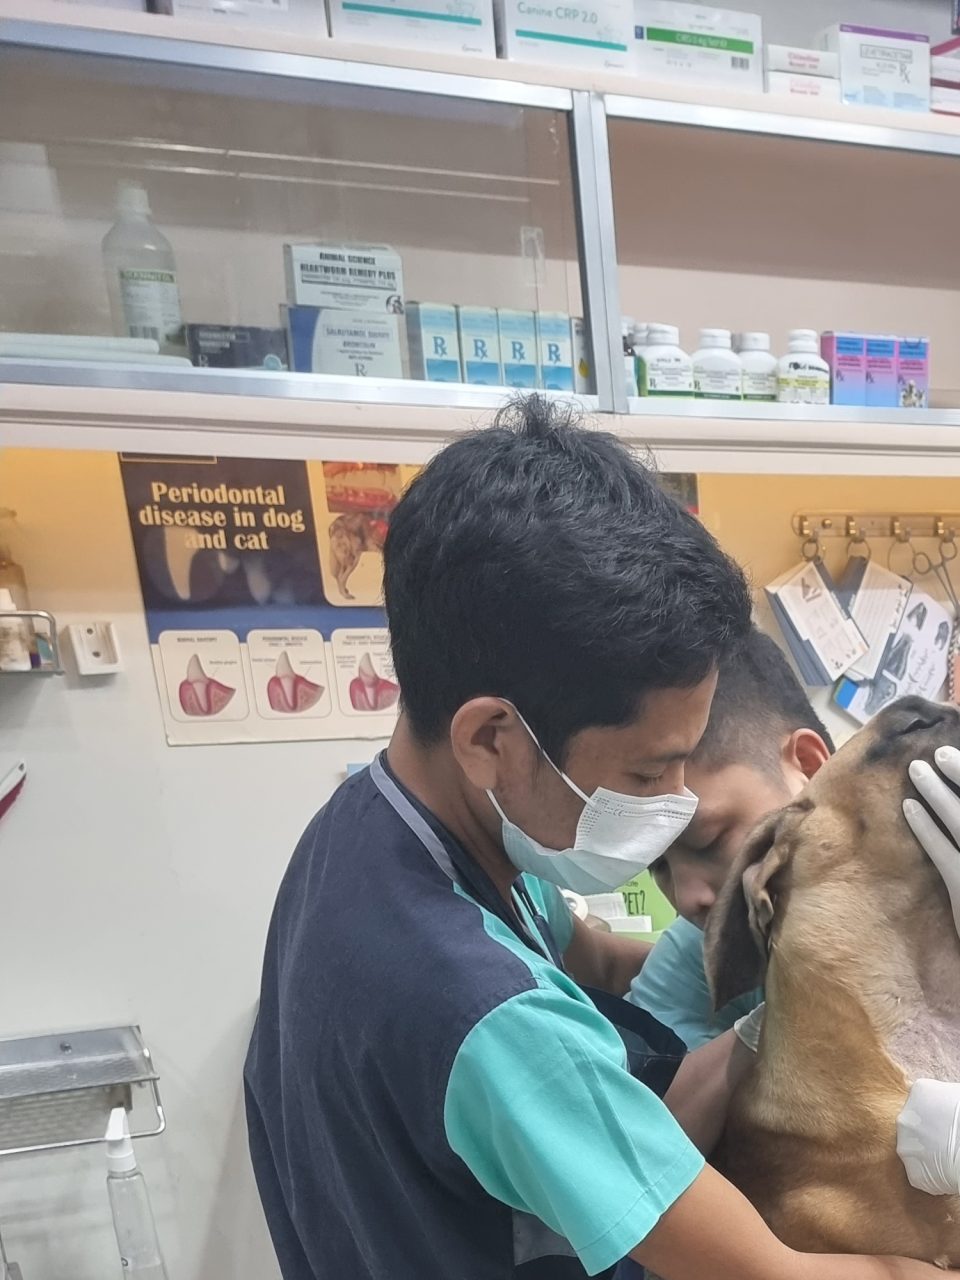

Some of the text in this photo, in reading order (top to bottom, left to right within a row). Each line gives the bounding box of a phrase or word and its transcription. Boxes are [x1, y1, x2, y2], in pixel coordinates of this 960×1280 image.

[555, 7, 580, 21] CRP
[581, 10, 599, 25] 2.0
[378, 271, 396, 280] PLUS
[150, 481, 286, 506] Periodontal
[138, 505, 306, 533] disease in dog
[184, 530, 270, 550] and cat
